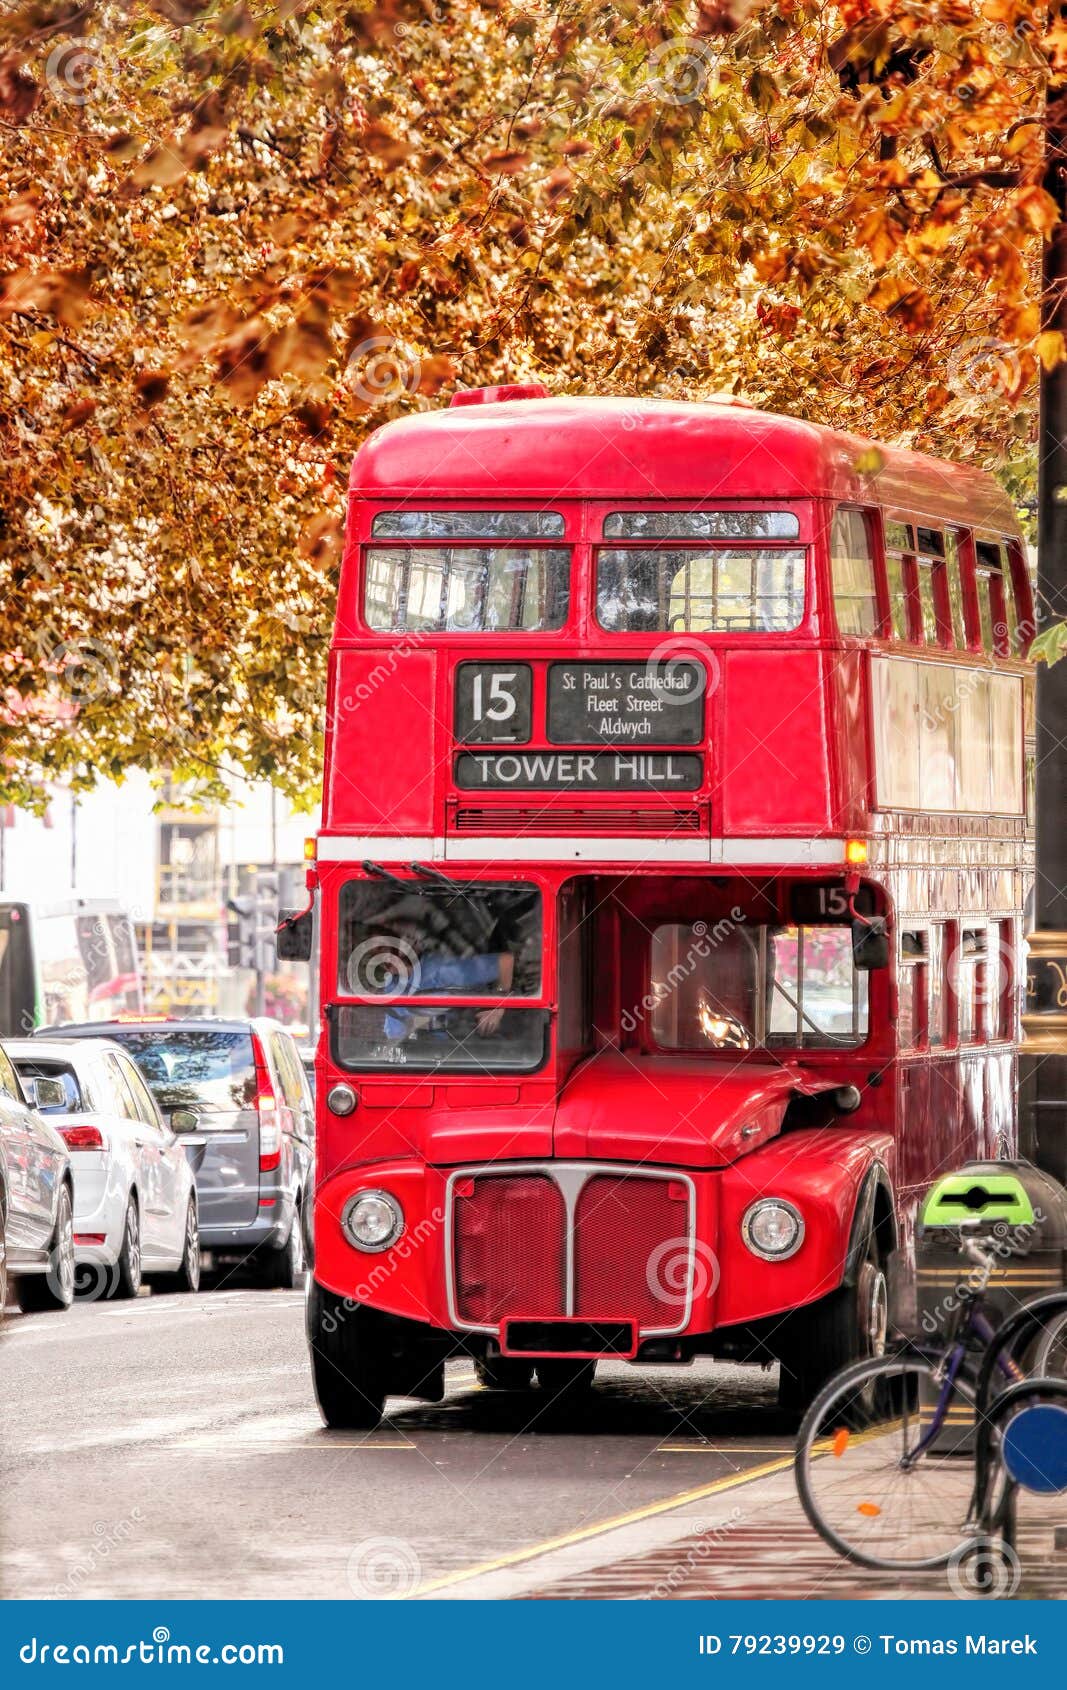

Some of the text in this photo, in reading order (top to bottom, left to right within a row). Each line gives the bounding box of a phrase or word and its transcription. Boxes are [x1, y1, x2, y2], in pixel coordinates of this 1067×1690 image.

[562, 672, 689, 690] St Paul's Cathedral
[473, 673, 517, 721] 15
[587, 695, 664, 712] Fleet Street
[599, 717, 651, 738] Aldwych
[475, 755, 683, 782] TOWER HILL
[819, 887, 848, 915] 15
